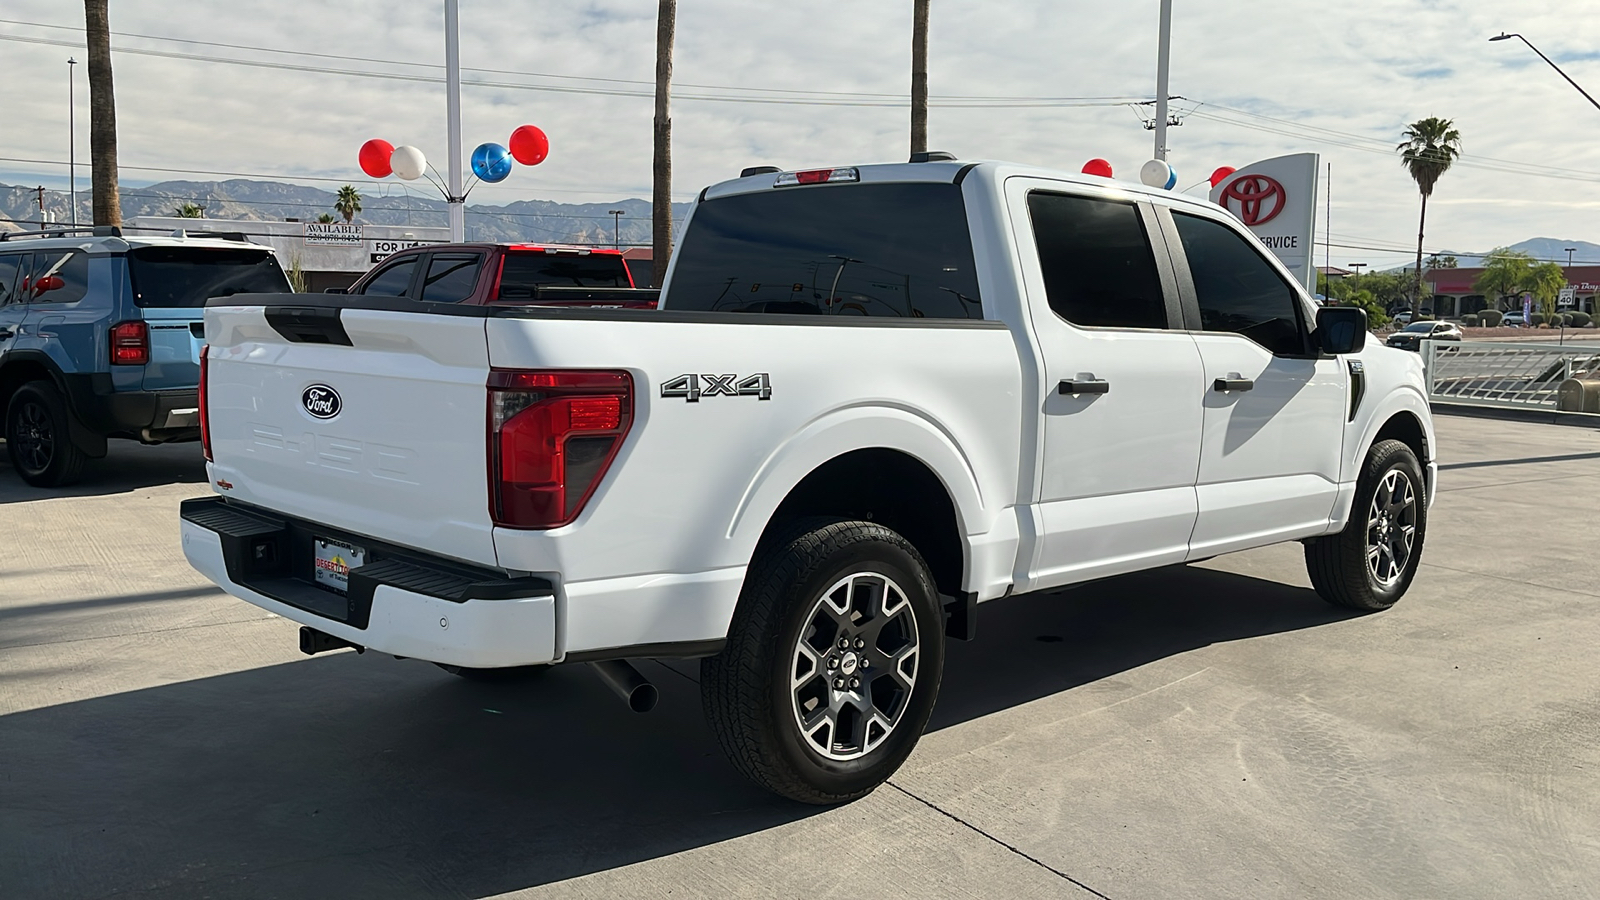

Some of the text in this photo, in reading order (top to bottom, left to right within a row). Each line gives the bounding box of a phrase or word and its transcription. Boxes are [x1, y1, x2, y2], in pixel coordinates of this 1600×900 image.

[306, 224, 361, 234] AVAILABLE
[375, 242, 398, 252] FOR
[1259, 236, 1298, 248] ERVICE
[307, 389, 333, 413] Ford
[316, 558, 338, 573] DESERT
